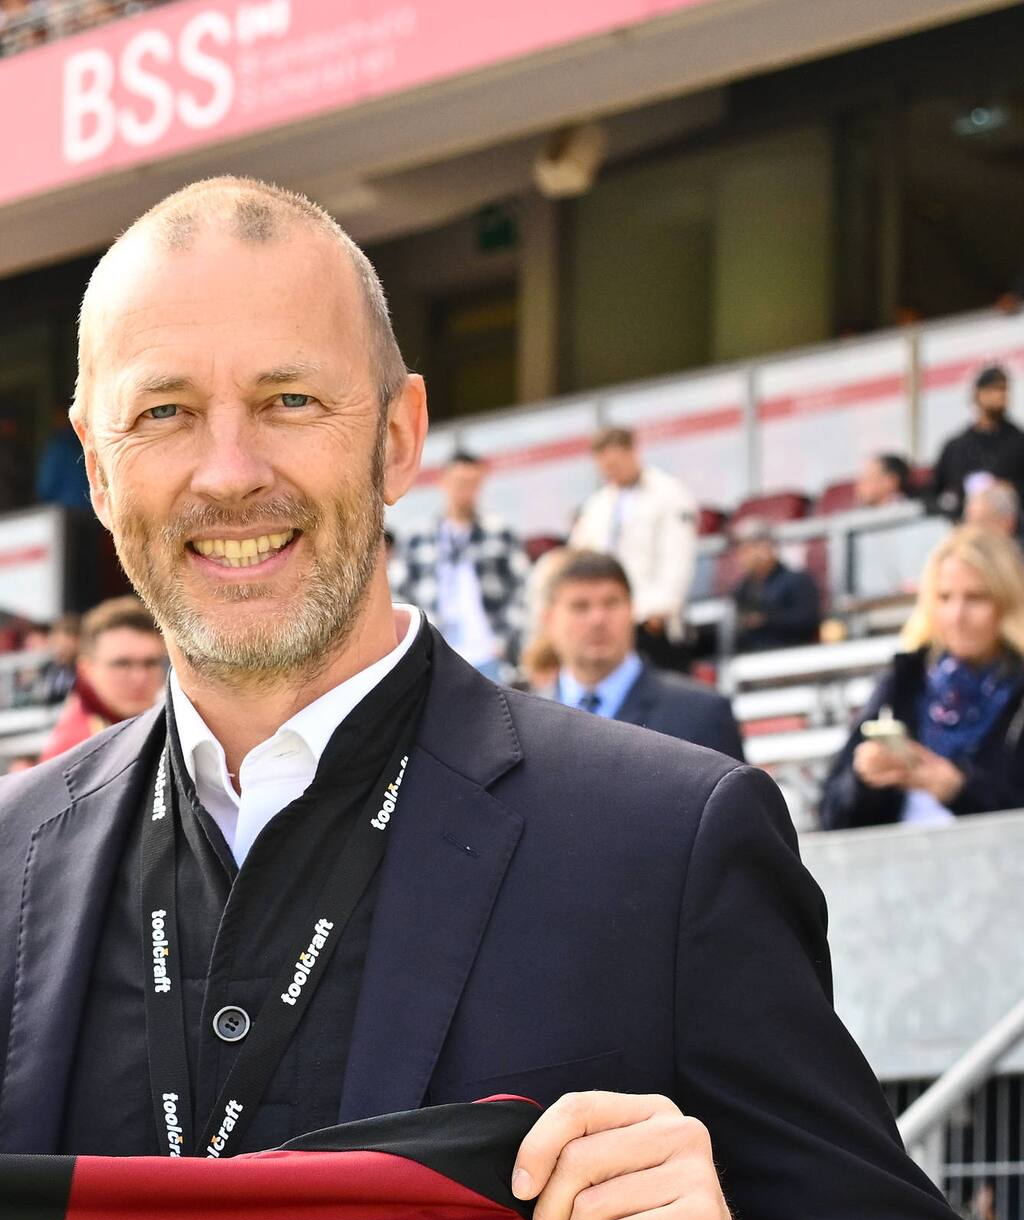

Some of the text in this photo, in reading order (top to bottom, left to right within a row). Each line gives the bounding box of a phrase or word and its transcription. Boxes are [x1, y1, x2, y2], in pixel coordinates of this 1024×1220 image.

[61, 9, 236, 164] BSS
[151, 909, 172, 993] toolcraft
[280, 918, 334, 1006] toolcraft
[206, 1099, 244, 1158] lcraft
